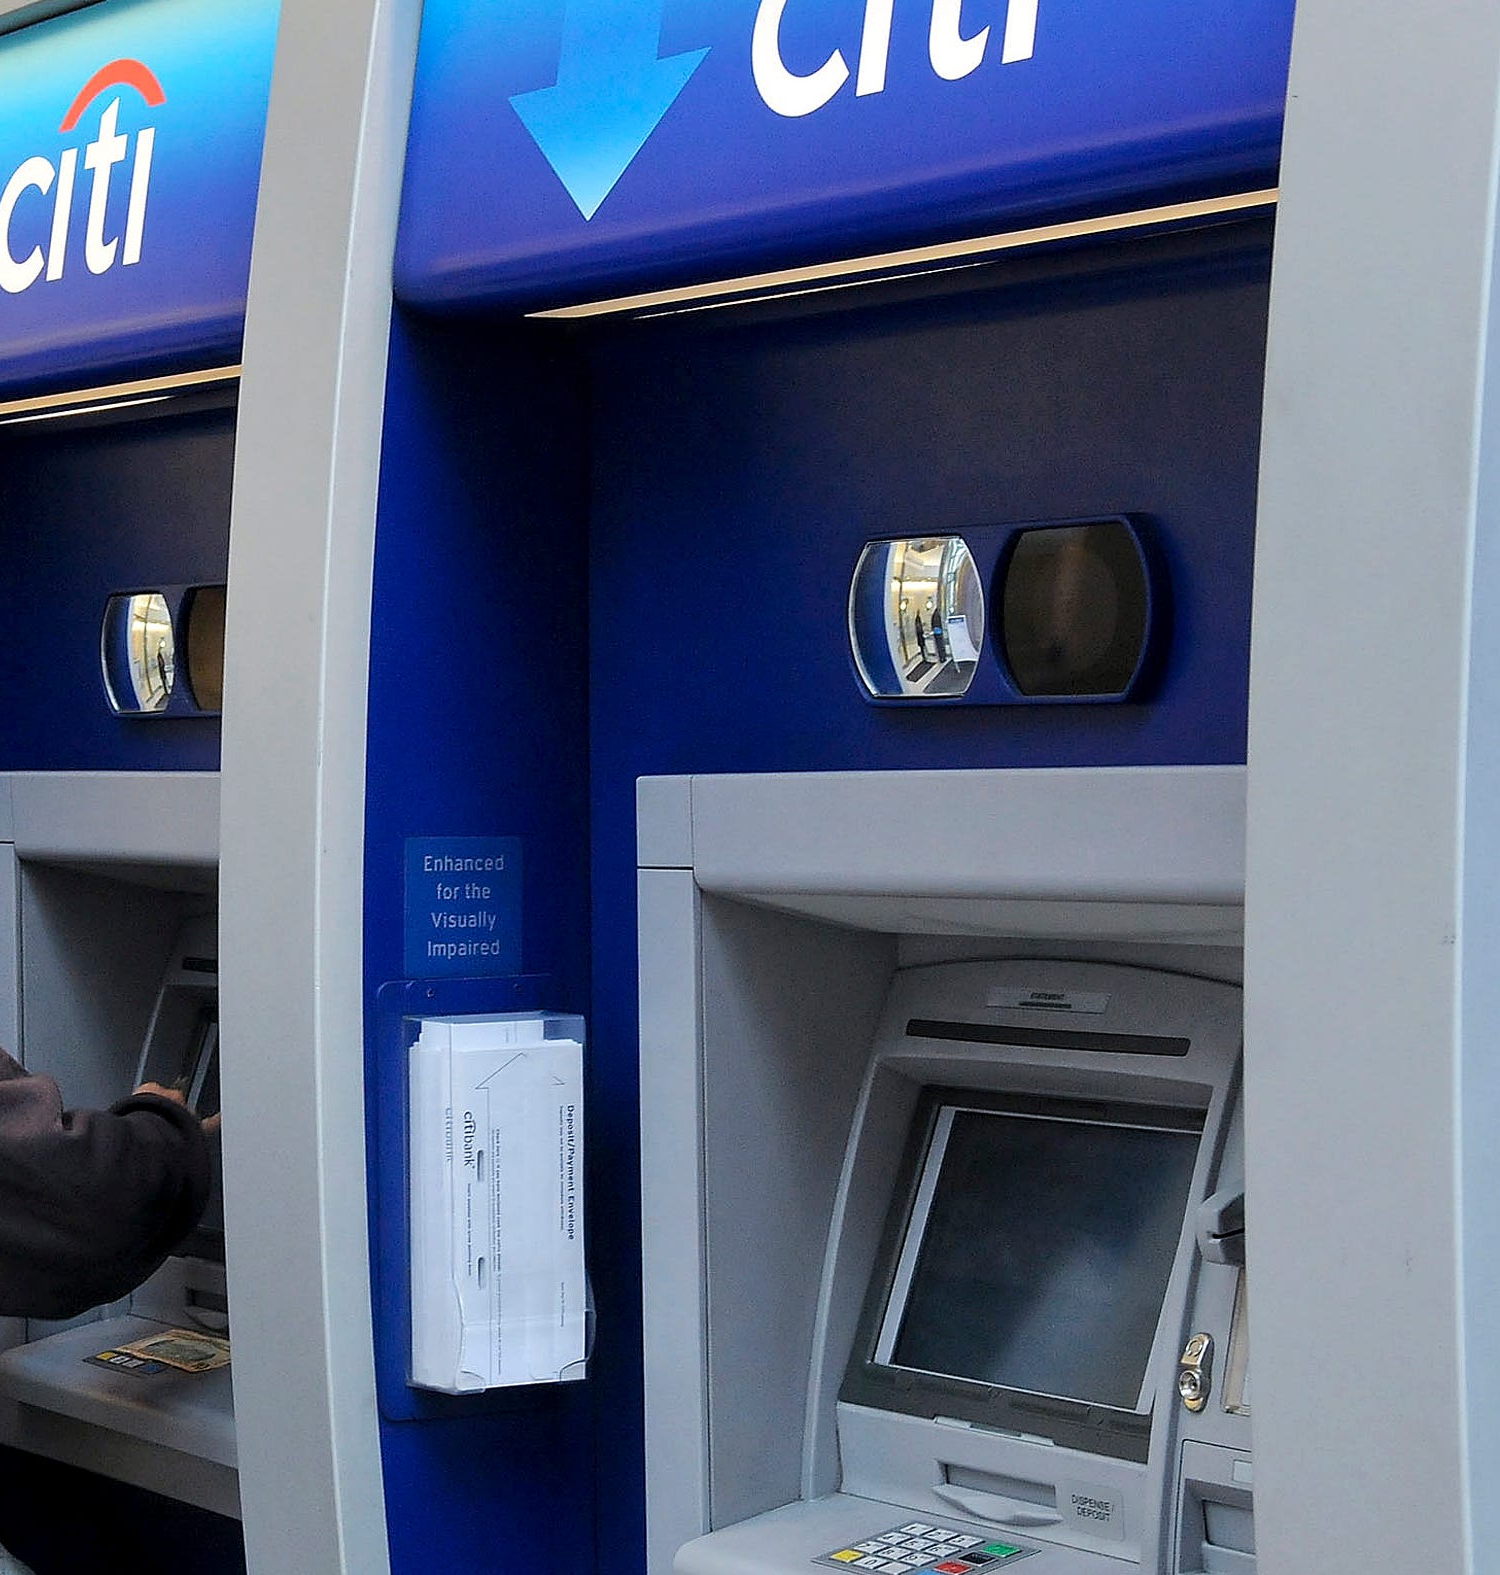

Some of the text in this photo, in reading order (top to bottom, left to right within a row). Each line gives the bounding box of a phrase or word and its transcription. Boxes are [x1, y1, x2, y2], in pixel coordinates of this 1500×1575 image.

[423, 855, 505, 872] Enhanced
[436, 883, 491, 900] for the
[430, 911, 497, 931] Visually
[427, 940, 500, 960] Impaired
[464, 1111, 476, 1167] citibank
[567, 1105, 576, 1240] Deposit/Payment Envelope
